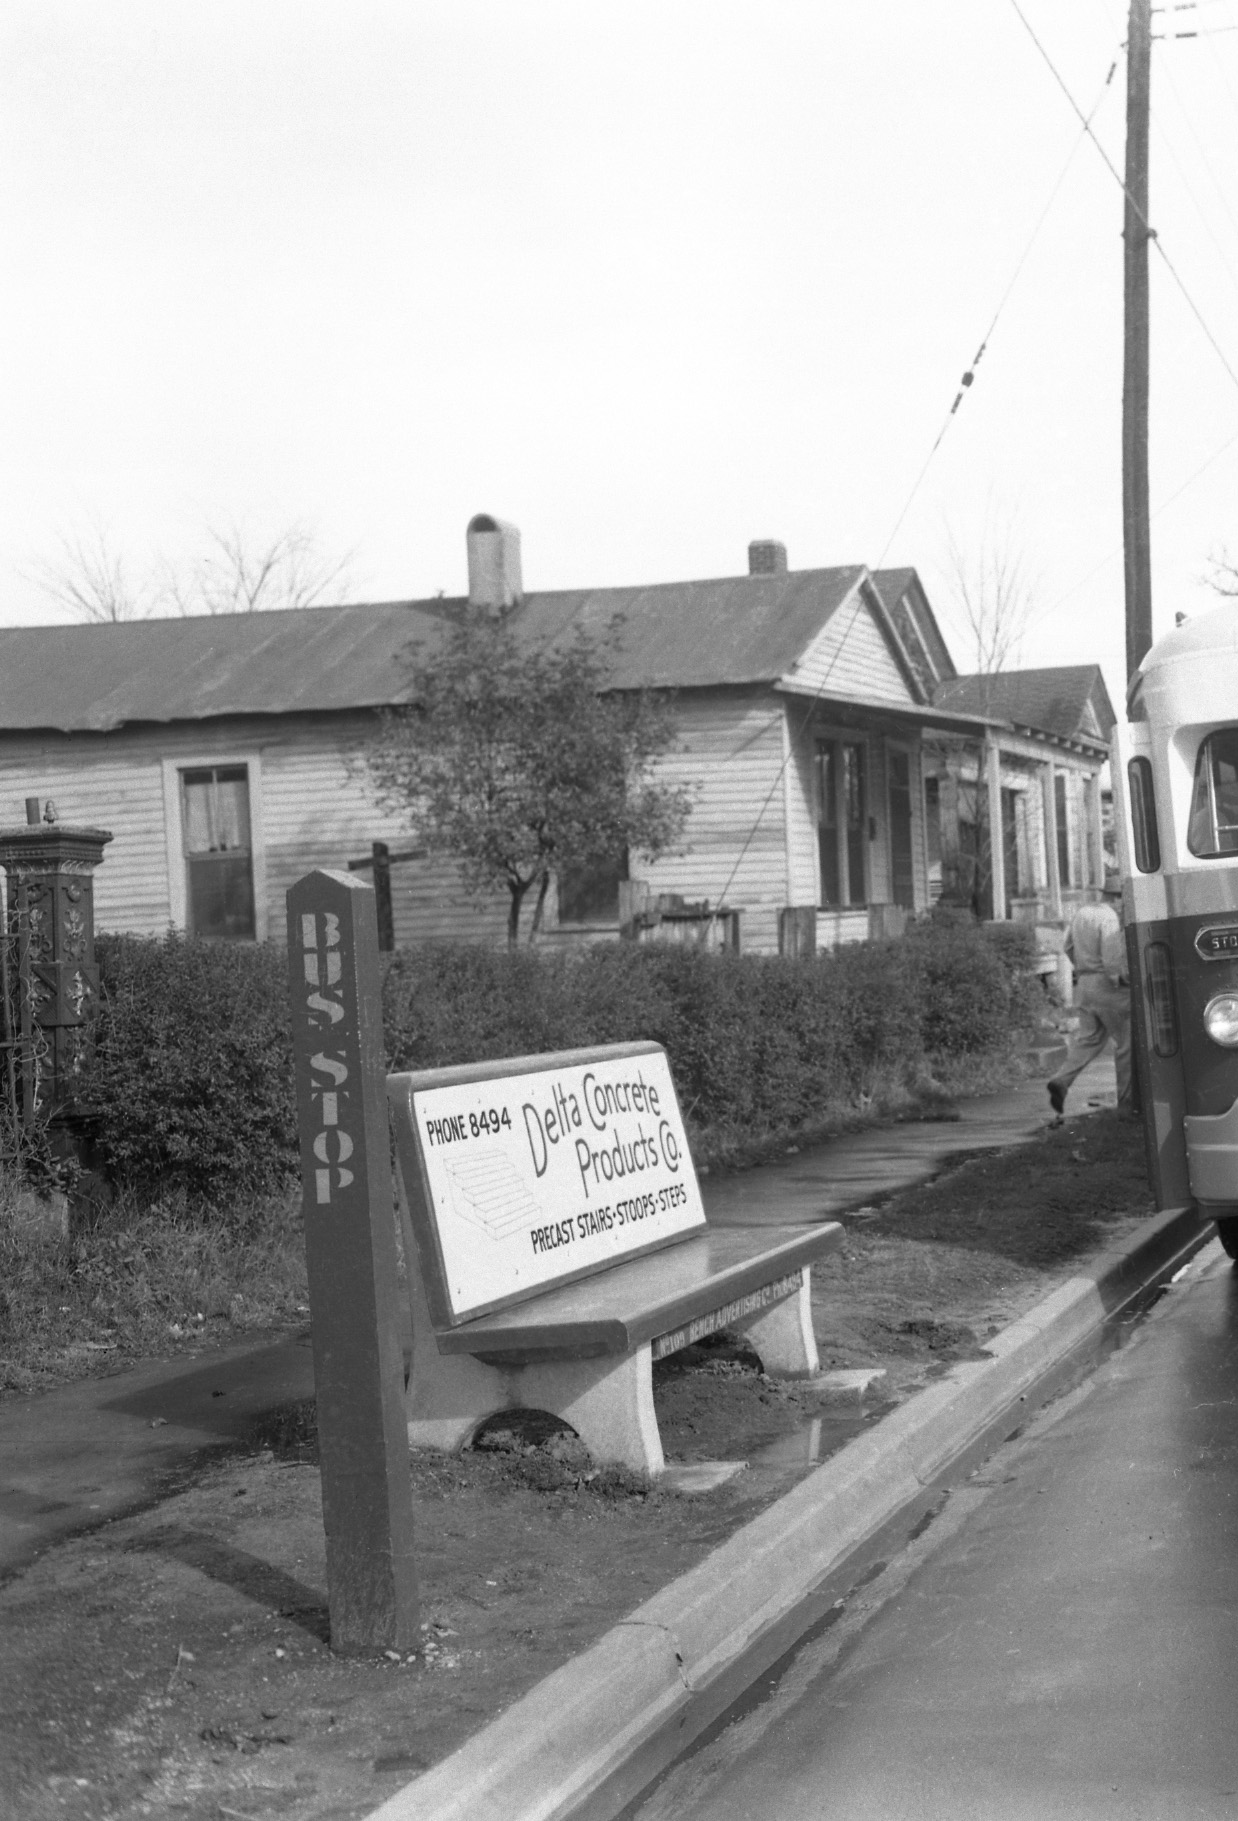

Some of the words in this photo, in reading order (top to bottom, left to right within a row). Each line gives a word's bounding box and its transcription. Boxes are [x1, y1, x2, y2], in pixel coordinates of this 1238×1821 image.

[301, 912, 345, 1025] BUS
[310, 1051, 354, 1204] STOP
[426, 1115, 468, 1146] PHONE
[469, 1106, 512, 1138] 8494
[522, 1083, 582, 1178] Delta
[583, 1070, 661, 1131] Concrete
[575, 1123, 658, 1199] Products
[659, 1120, 682, 1173] Co.
[531, 1218, 576, 1254] PRECAST
[658, 1183, 687, 1211] STEPS
